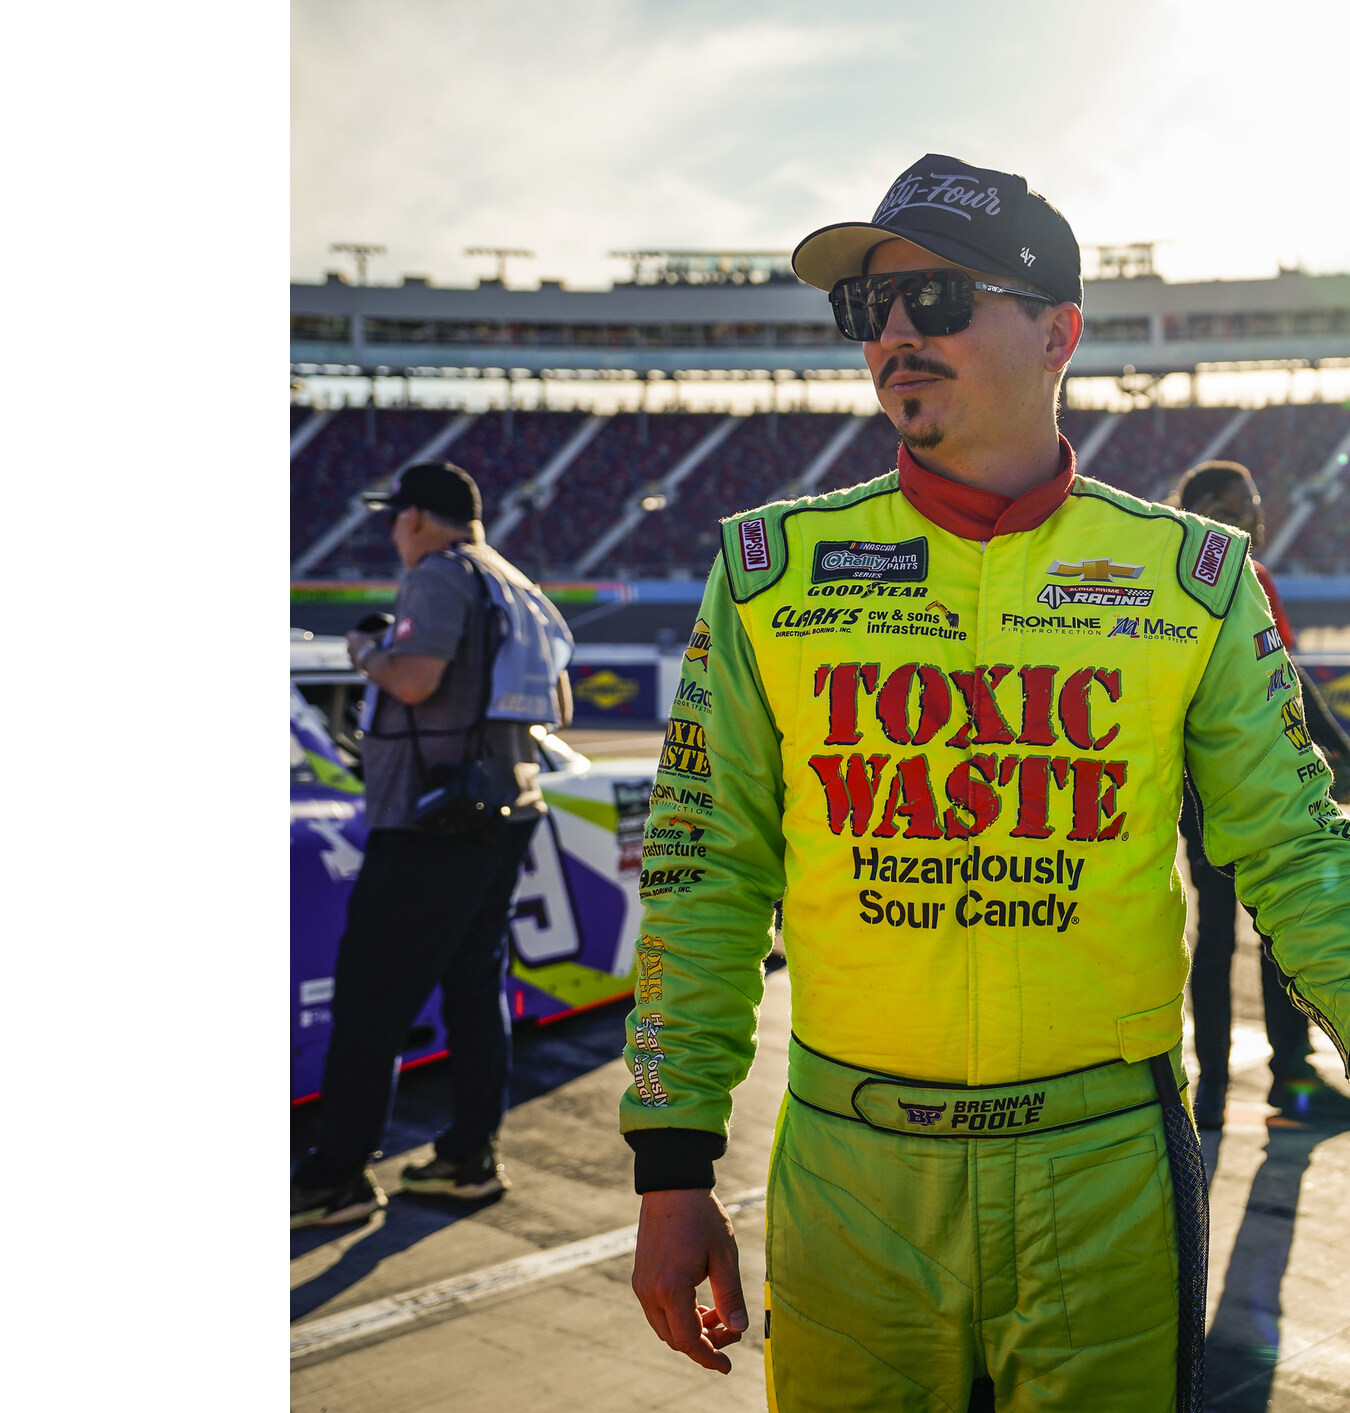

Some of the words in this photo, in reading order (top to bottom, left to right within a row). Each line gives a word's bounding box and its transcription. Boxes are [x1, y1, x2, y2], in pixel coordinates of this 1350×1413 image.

[743, 521, 765, 565] SIMPSON
[863, 543, 896, 551] NASCAR
[887, 562, 918, 570] PARTS
[891, 554, 917, 563] AUTO
[1199, 532, 1227, 581] SIMPSON
[1073, 593, 1150, 605] RACING
[772, 606, 863, 628] CLARK'S
[868, 610, 888, 620] cw
[892, 610, 903, 620] &
[907, 612, 940, 624] sons
[1001, 613, 1101, 629] FRONTLINE
[867, 621, 967, 641] infrastructure
[1144, 618, 1198, 639] Macc
[675, 678, 712, 708] Macc
[814, 662, 1123, 750] TOXIC
[808, 753, 1128, 842] WASTE
[852, 845, 1085, 891] Hazardously
[859, 890, 945, 930] Sour
[955, 889, 1078, 933] Candy
[953, 1091, 1046, 1113] BRENNAN
[951, 1106, 1043, 1131] POOLE
